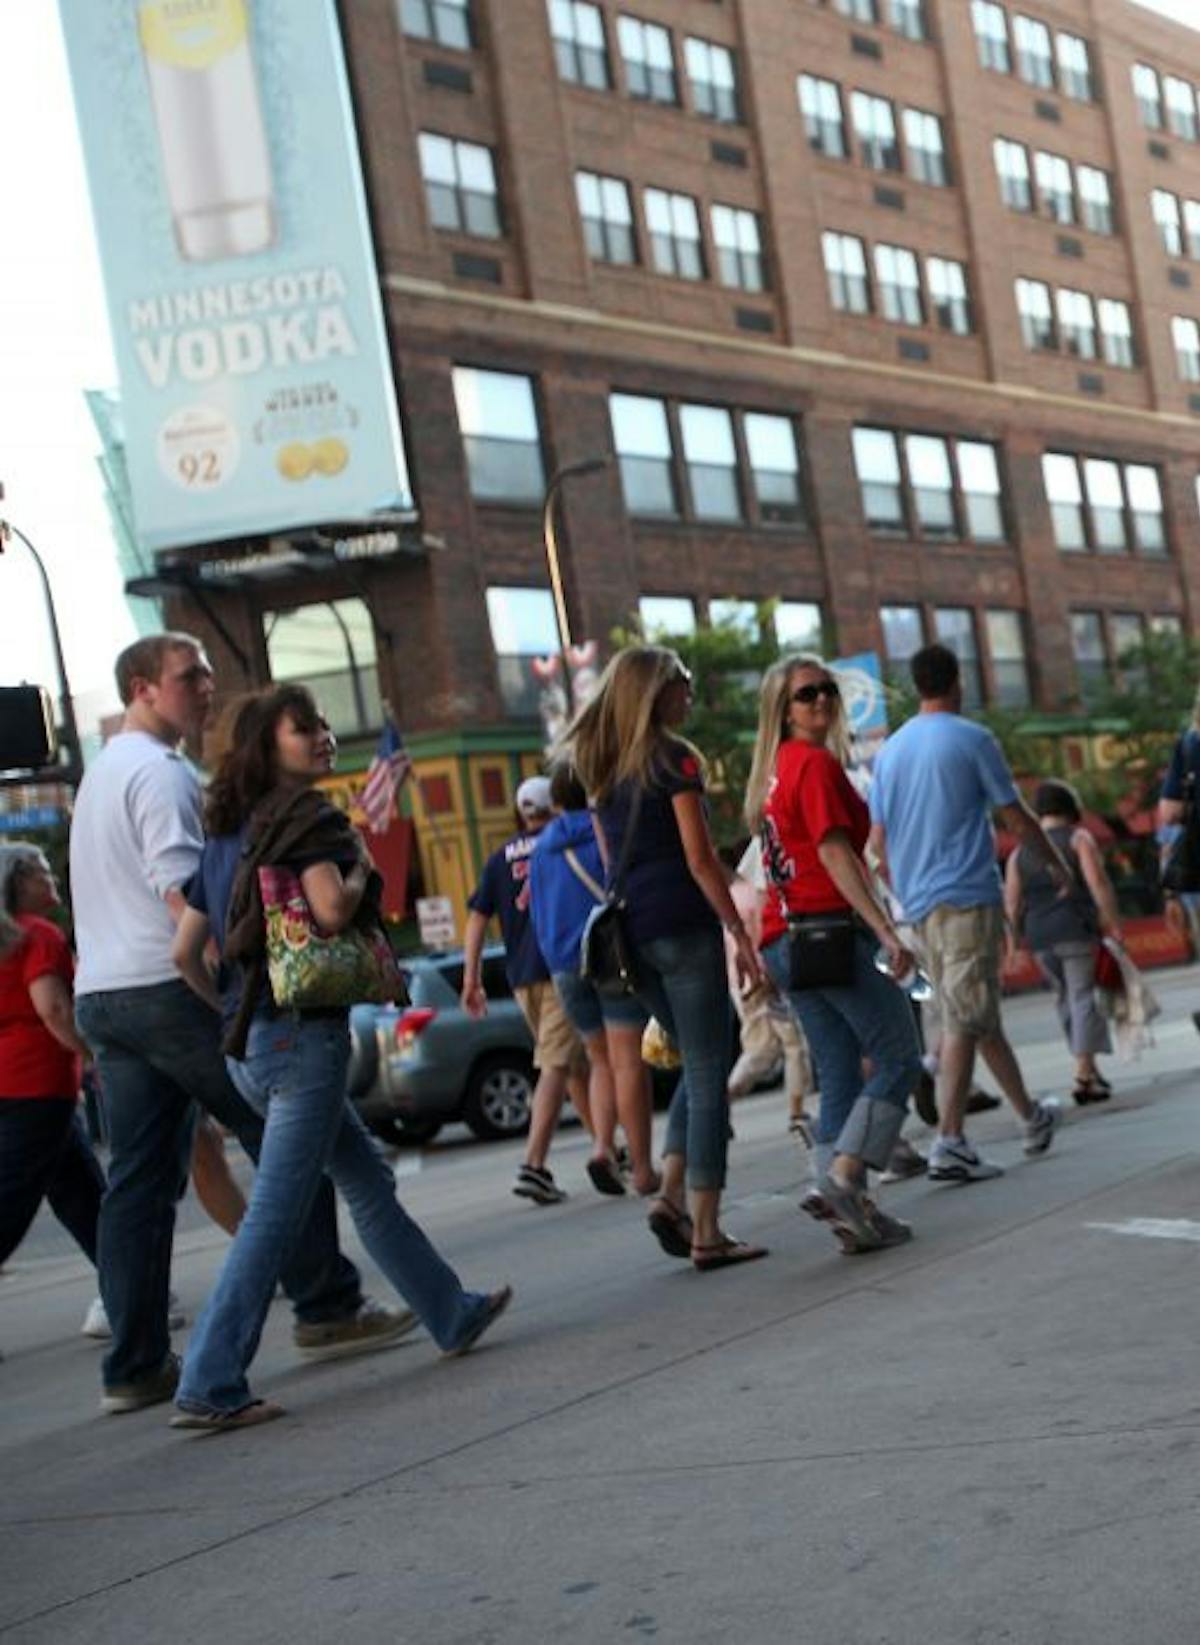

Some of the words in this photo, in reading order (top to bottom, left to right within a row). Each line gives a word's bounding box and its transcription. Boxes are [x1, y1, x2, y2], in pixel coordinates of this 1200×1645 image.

[129, 267, 346, 332] MINNESOTA
[136, 304, 357, 387] VODKA
[178, 449, 221, 484] 92
